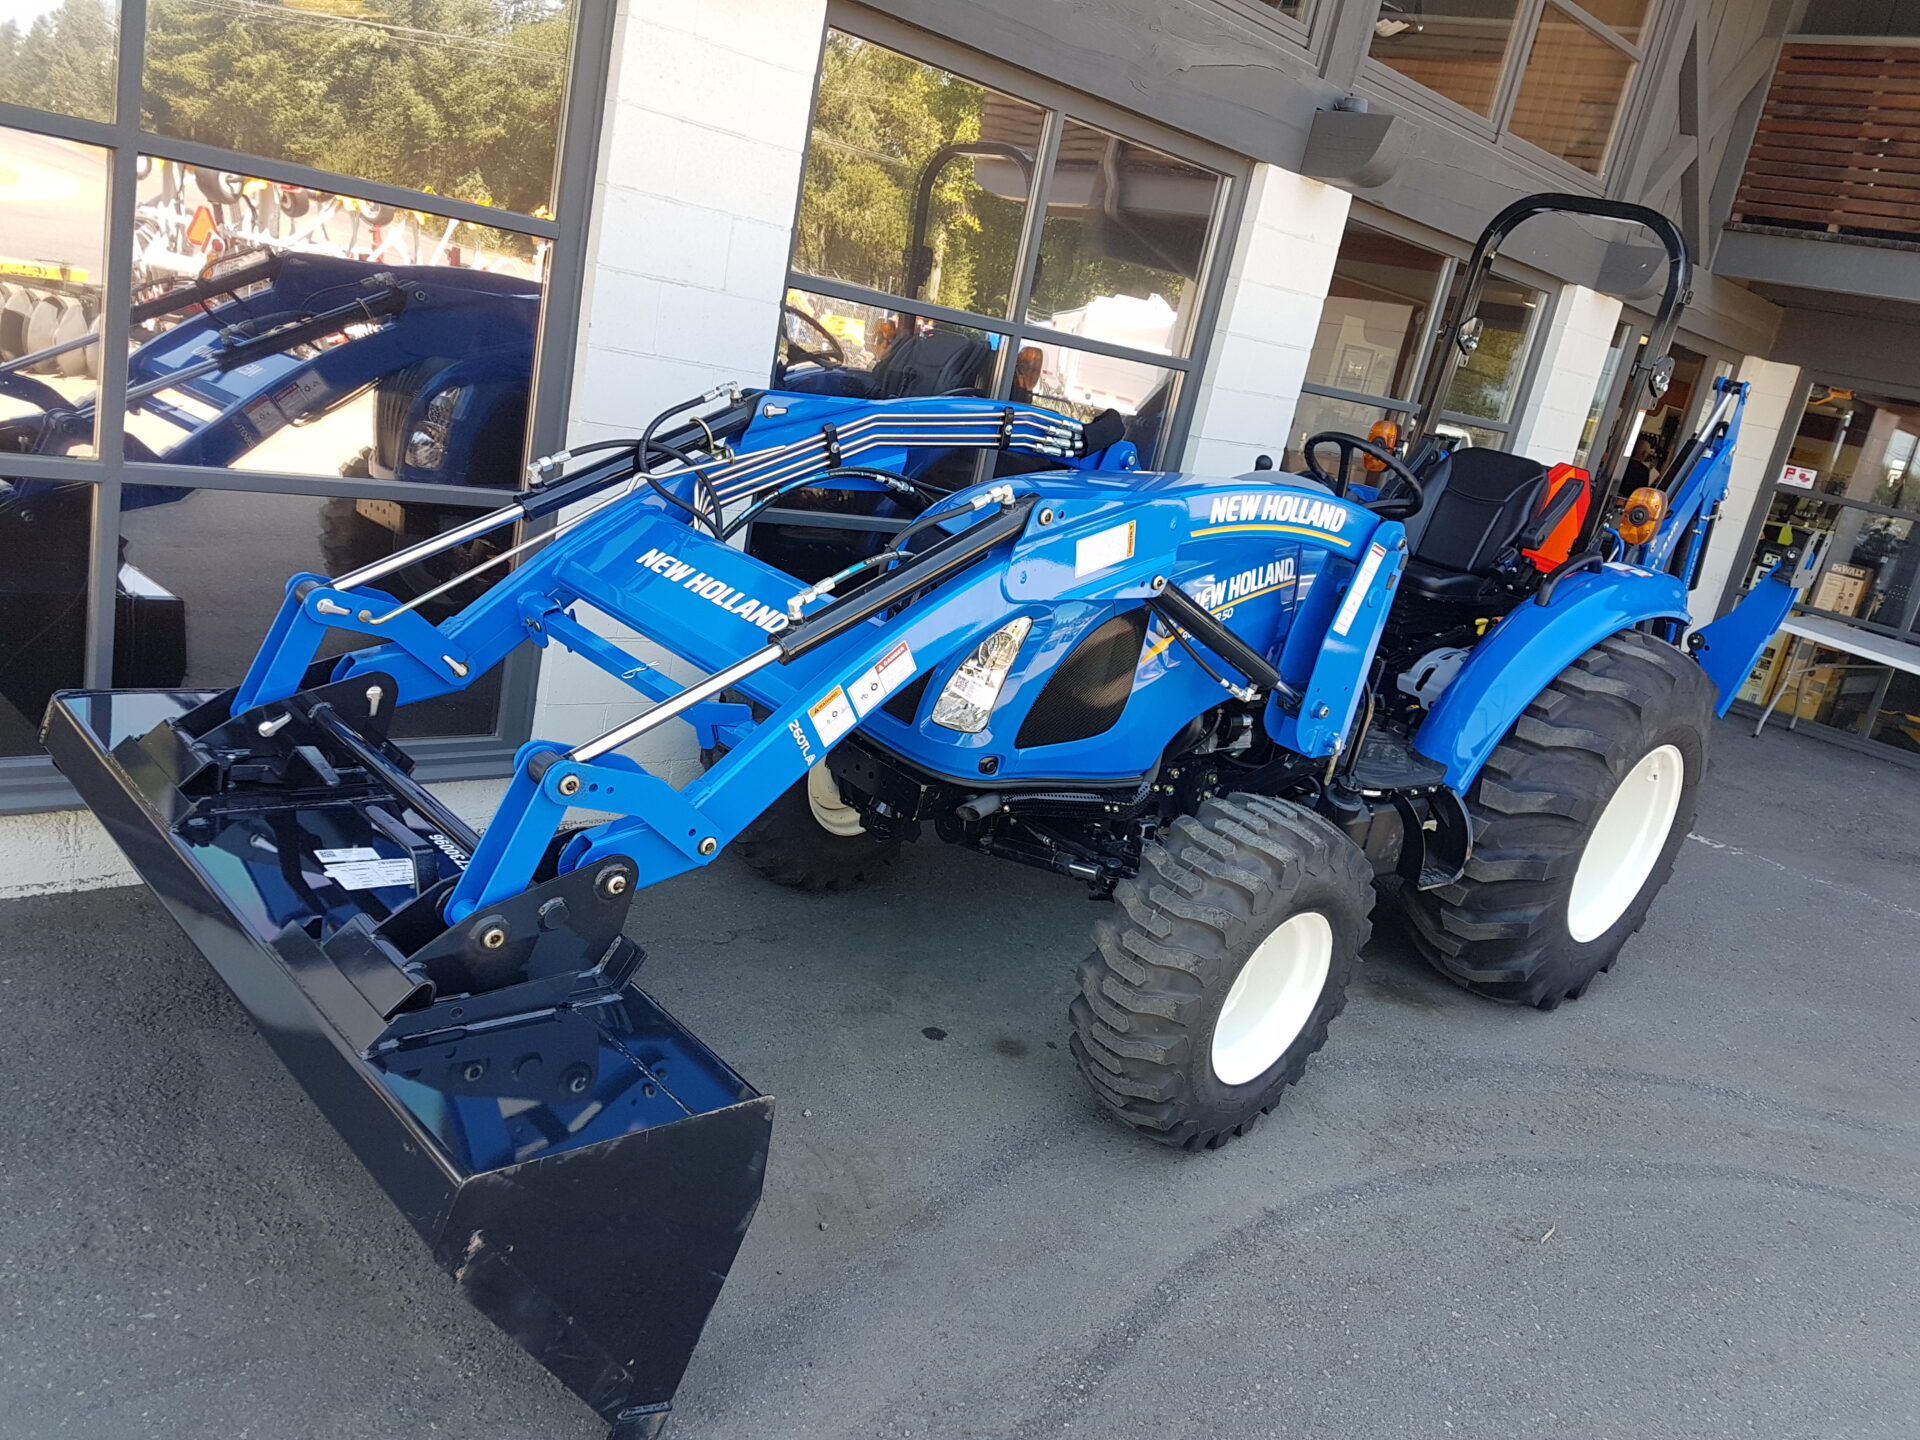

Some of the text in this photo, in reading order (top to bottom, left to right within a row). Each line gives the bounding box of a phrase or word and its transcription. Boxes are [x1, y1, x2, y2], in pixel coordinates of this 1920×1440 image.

[1209, 494, 1347, 533] NEW HOLLAND
[636, 548, 790, 634] NEW HOLLAND
[1228, 557, 1295, 601] HOLLAND
[787, 719, 816, 766] 260TLA
